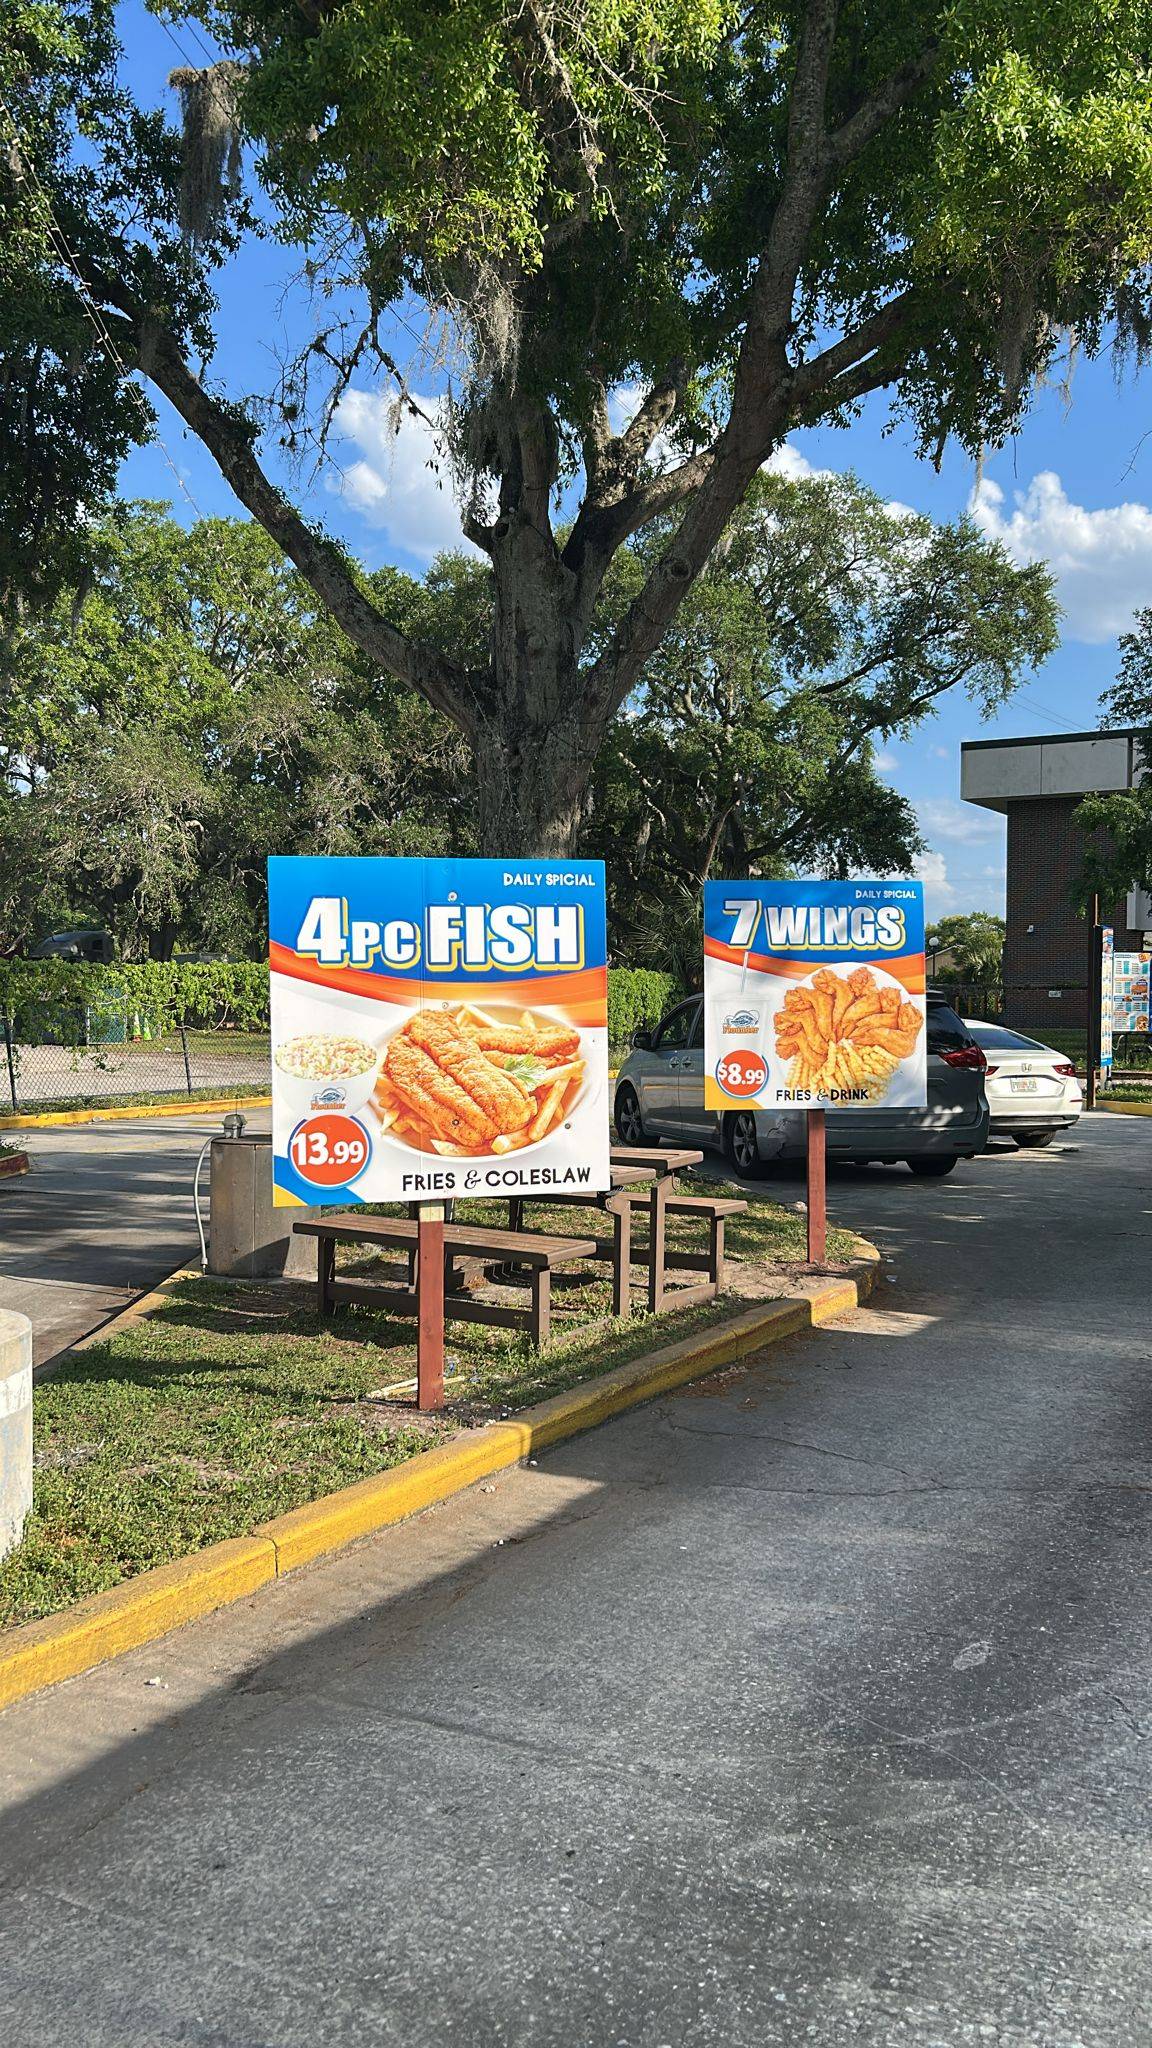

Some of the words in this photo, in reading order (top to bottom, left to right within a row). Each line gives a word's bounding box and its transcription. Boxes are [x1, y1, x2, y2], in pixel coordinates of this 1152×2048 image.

[503, 872, 542, 887] DAILY
[545, 873, 595, 887] SPICIAL
[855, 889, 882, 899] DAILY
[295, 896, 420, 970] 4PC
[425, 902, 584, 972] FISH
[723, 899, 762, 949] 7
[764, 905, 906, 951] WINGS
[718, 1063, 765, 1085] $8.99
[776, 1089, 811, 1102] FRIES
[816, 1088, 828, 1101] &
[831, 1088, 869, 1101] DRINK
[291, 1132, 364, 1166] 13.99
[402, 1173, 456, 1192] FRIES
[464, 1169, 482, 1190] &
[485, 1167, 591, 1187] COLESLAW
